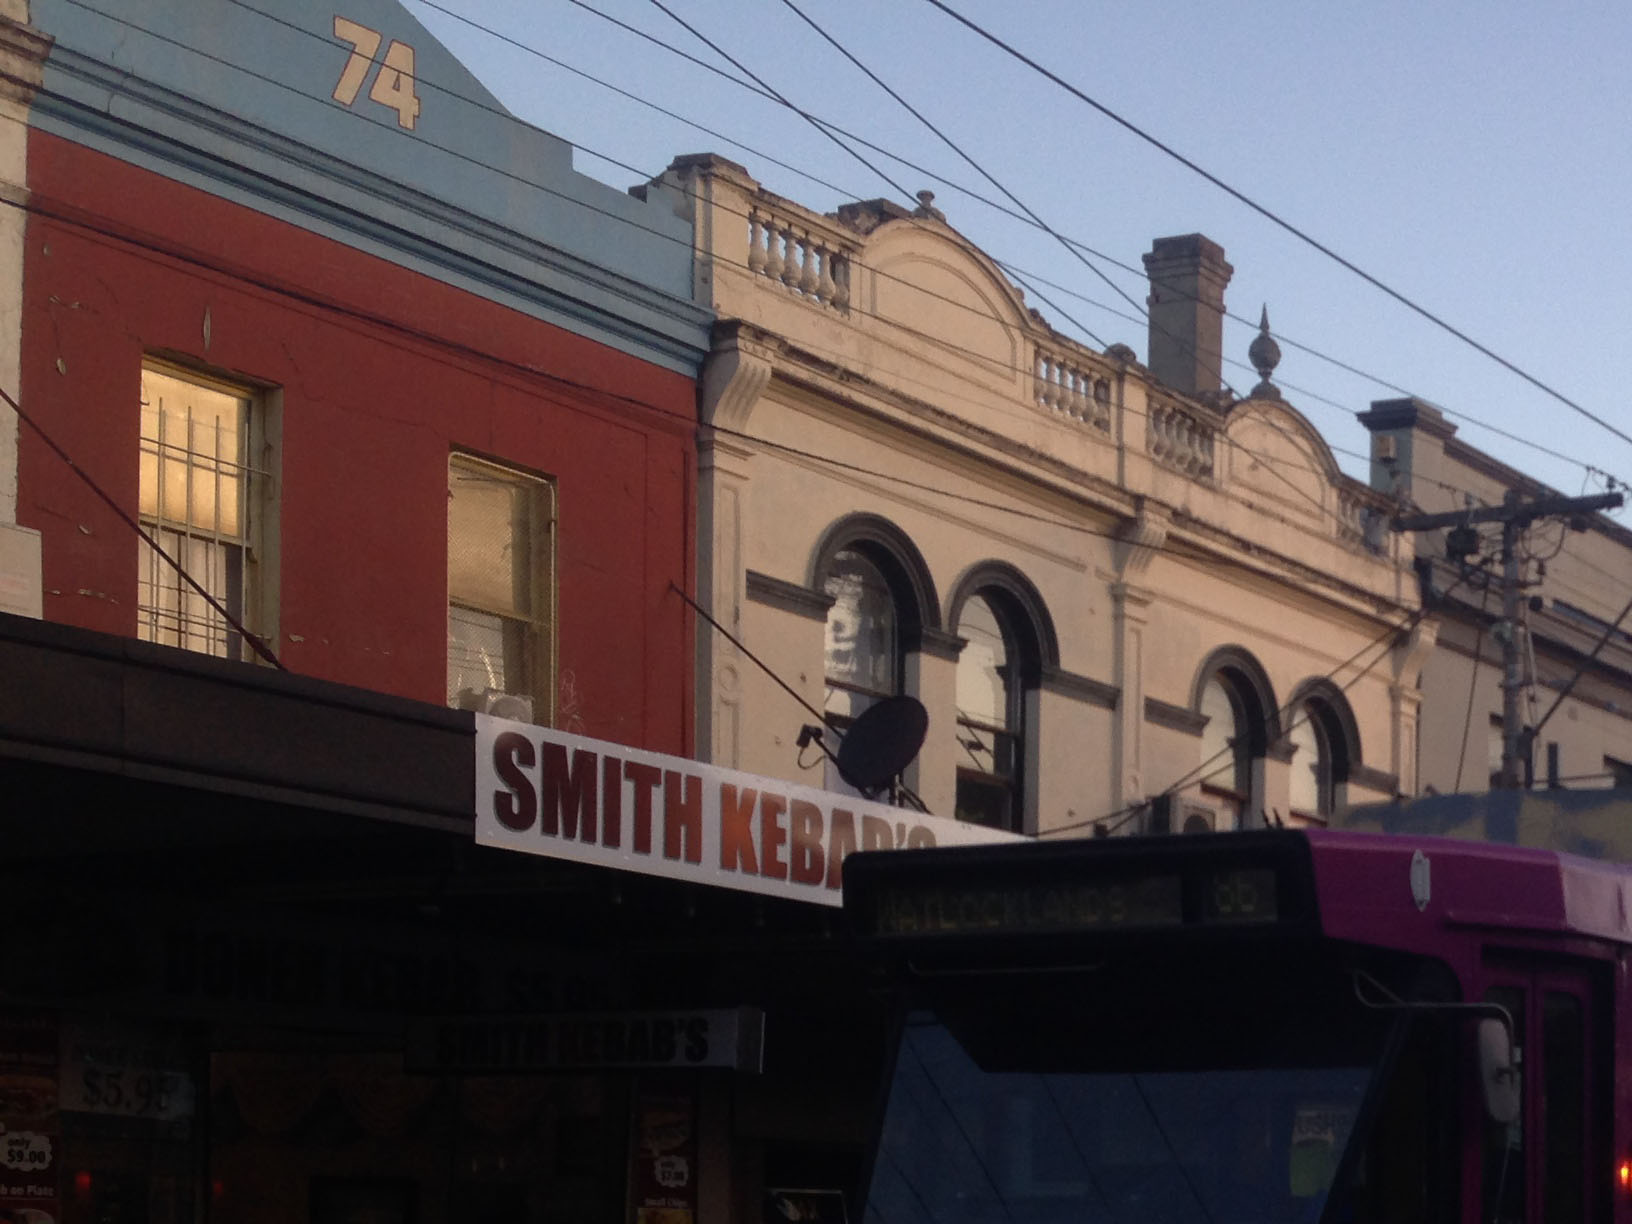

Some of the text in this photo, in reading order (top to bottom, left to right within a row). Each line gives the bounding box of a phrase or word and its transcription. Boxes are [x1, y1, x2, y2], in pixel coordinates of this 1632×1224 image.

[332, 15, 420, 131] 74
[492, 731, 702, 865] SMITH
[558, 1017, 709, 1063] KEBAB'S
[7, 1150, 46, 1163] $9.00
